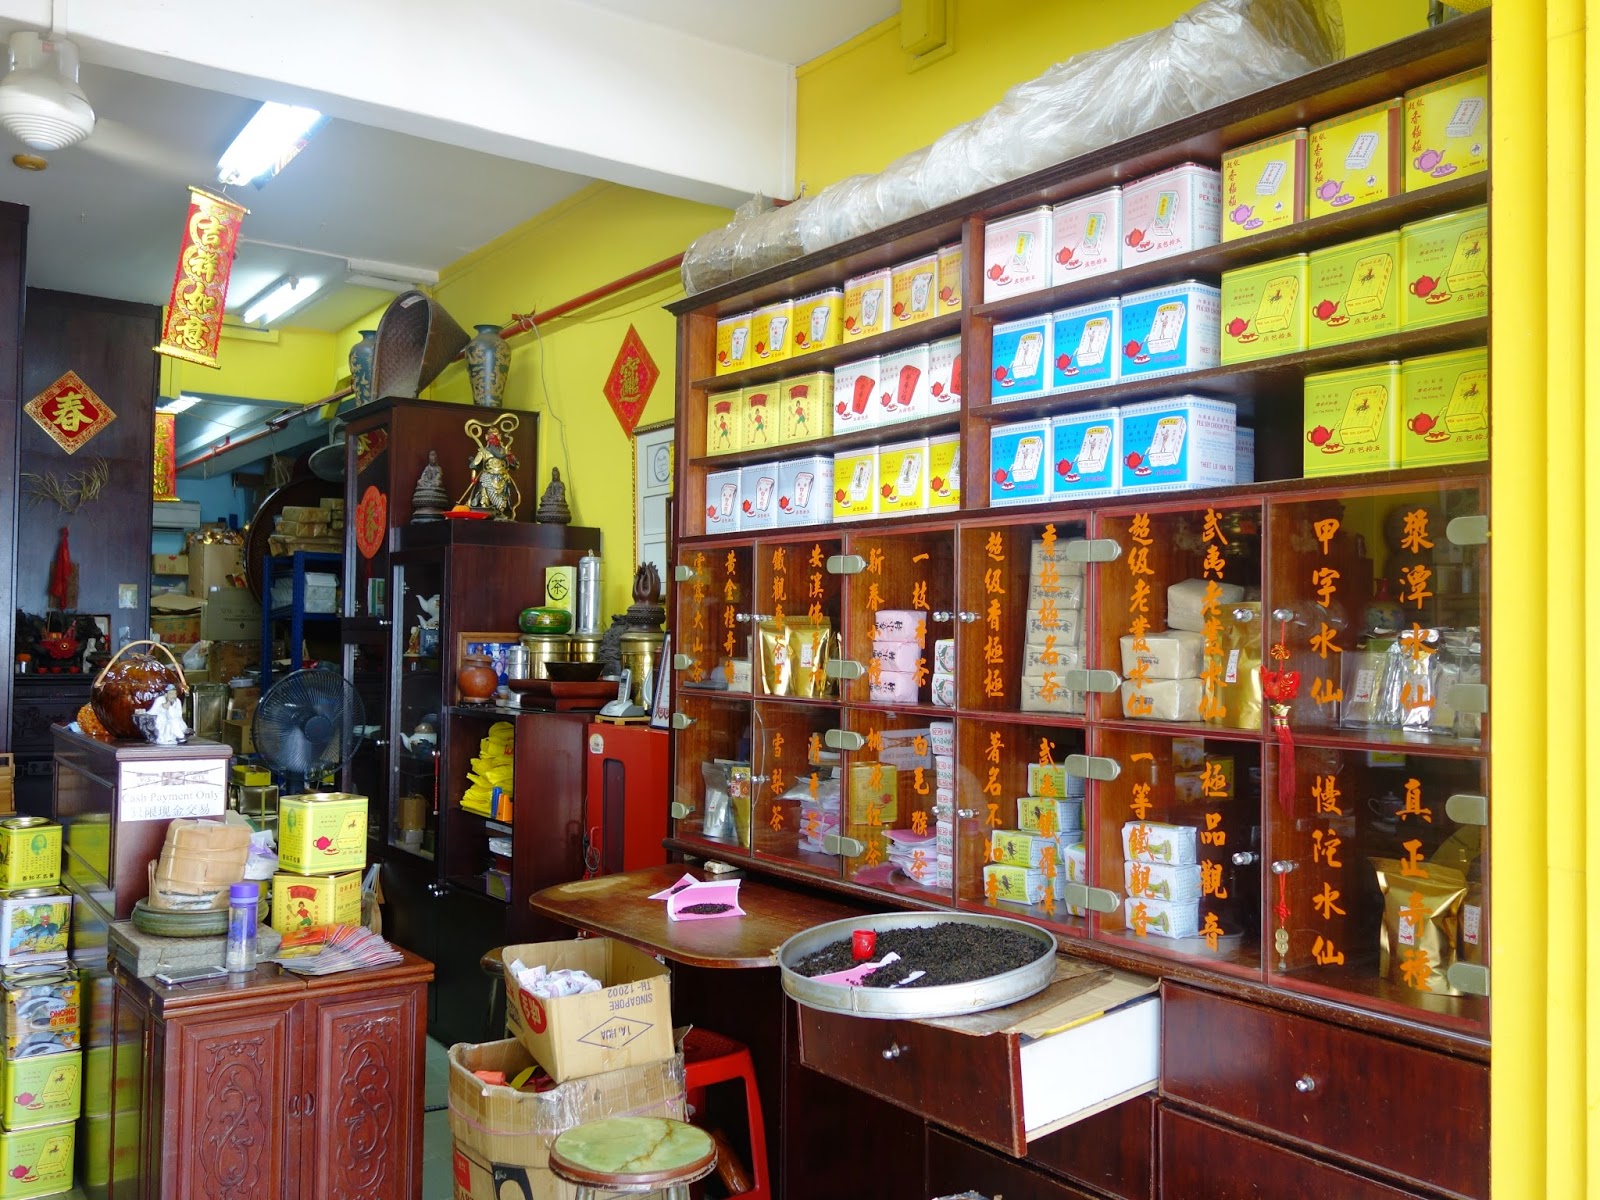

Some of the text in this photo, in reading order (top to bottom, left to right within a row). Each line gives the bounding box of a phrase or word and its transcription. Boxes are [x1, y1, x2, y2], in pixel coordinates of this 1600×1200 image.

[175, 215, 227, 350] 吉祥如意
[51, 390, 93, 432] 春
[551, 578, 567, 595] 茶
[1310, 518, 1344, 706] 甲字水仙
[122, 790, 219, 804] Cash Payment Only
[131, 803, 210, 818] 只限现金交易
[609, 993, 653, 1011] SINGAPORE
[49, 1007, 77, 1018] CHEONG
